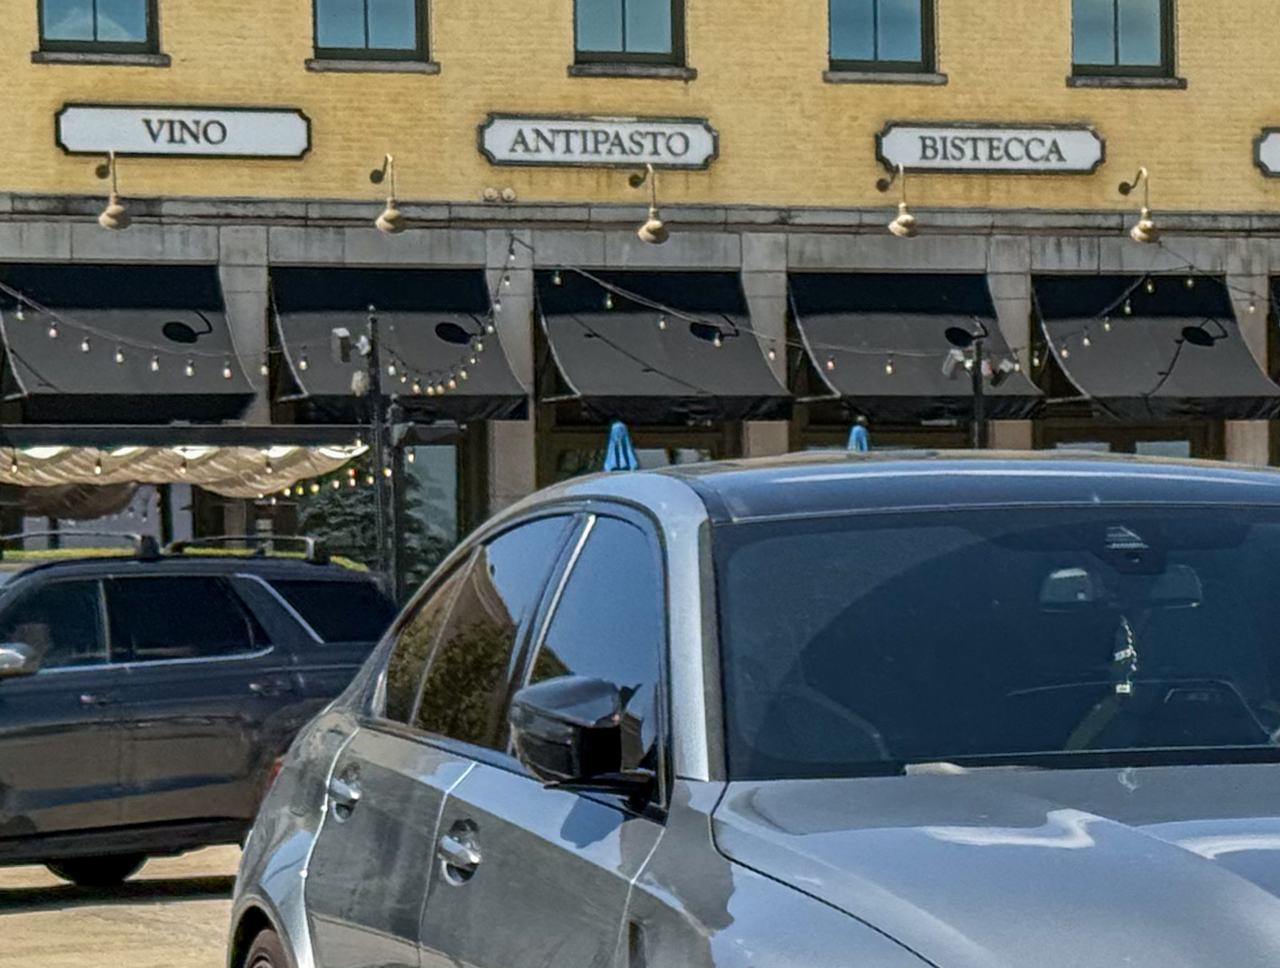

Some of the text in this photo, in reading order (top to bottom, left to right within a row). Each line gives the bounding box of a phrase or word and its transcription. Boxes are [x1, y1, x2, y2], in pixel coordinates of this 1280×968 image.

[141, 118, 227, 145] VINO
[508, 128, 690, 156] ANTIPASTO
[919, 136, 1067, 162] BISTECCA
